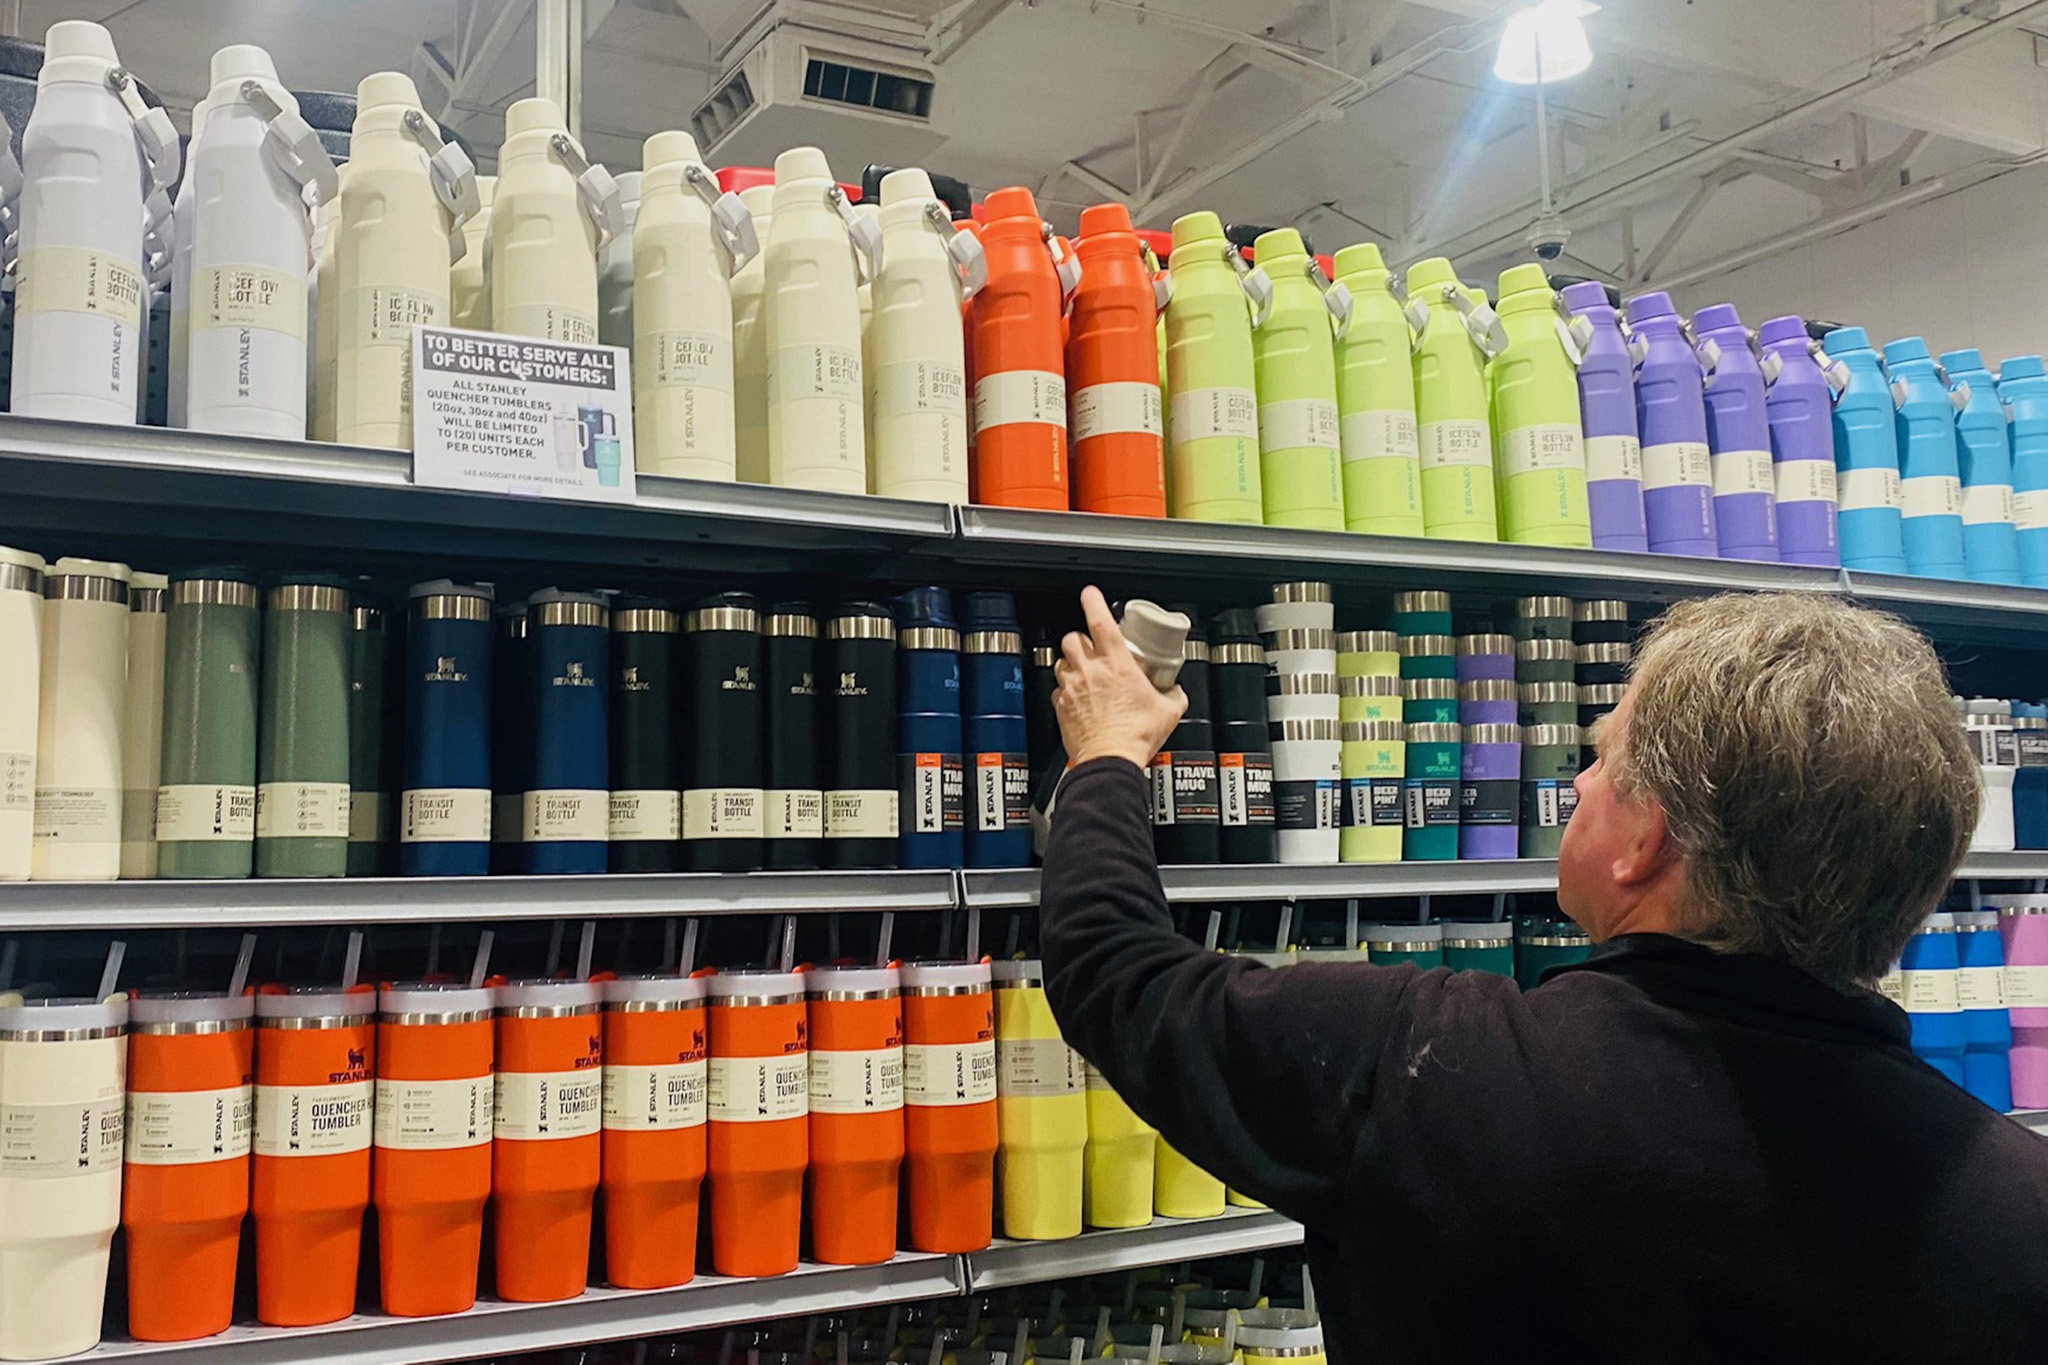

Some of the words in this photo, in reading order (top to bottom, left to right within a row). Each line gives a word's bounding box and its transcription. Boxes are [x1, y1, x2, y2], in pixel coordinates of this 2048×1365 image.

[111, 321, 123, 380] STANLEY
[239, 327, 251, 386] STANLEY
[424, 334, 448, 351] TO
[451, 338, 520, 359] BETTER
[522, 346, 578, 366] SERVE
[580, 352, 613, 370] ALL
[431, 351, 456, 367] OF
[459, 355, 496, 373] OUR
[499, 359, 607, 385] CUSTOMERS:
[453, 380, 474, 391] ALL
[476, 382, 527, 396] STANLEY
[427, 389, 490, 405] QUENCHER
[491, 396, 552, 411] TUMBLERS
[468, 406, 494, 418] 30oz
[496, 411, 516, 421] and
[684, 387, 696, 439] STANLEY
[443, 416, 473, 428] WILL
[475, 420, 490, 430] BE
[492, 421, 538, 435] LIMITED
[437, 428, 452, 438] TO
[478, 432, 513, 444] UNITS
[515, 436, 545, 447] EACH
[942, 413, 951, 463] STANLEY
[446, 441, 469, 453] PER
[471, 444, 537, 460] CUSTOMER.
[463, 469, 478, 477] SEE
[425, 672, 468, 682] STANLEY
[553, 676, 595, 687] STANLEY
[1174, 766, 1216, 779] TRAVEL
[924, 770, 933, 815] STANLEY
[986, 769, 995, 814] STANLEY
[1157, 768, 1166, 810] STANLEY
[1175, 779, 1206, 791] MUG
[1228, 769, 1238, 811] STANLEY
[1246, 781, 1271, 793] MUG
[1373, 785, 1398, 797] BEER
[1424, 787, 1452, 797] BEER
[215, 788, 224, 824] STANLEY
[419, 799, 455, 809] TRANSIT
[546, 799, 582, 810] TRANSIT
[725, 798, 754, 807] TRANSIT
[832, 799, 862, 808] TRANSIT
[1373, 796, 1397, 805] PINT
[1425, 797, 1450, 806] PINT
[418, 809, 450, 820] BOTTLE
[546, 809, 576, 820] BOTTLE
[724, 807, 752, 817] BOTTLE
[832, 809, 858, 818] BOTTLE
[291, 1093, 300, 1137] STANLEY
[311, 1099, 366, 1117] QUENCHER
[215, 1098, 224, 1141] STANLEY
[311, 1113, 361, 1131] TUMBLER
[81, 1109, 90, 1154] STANLEY
